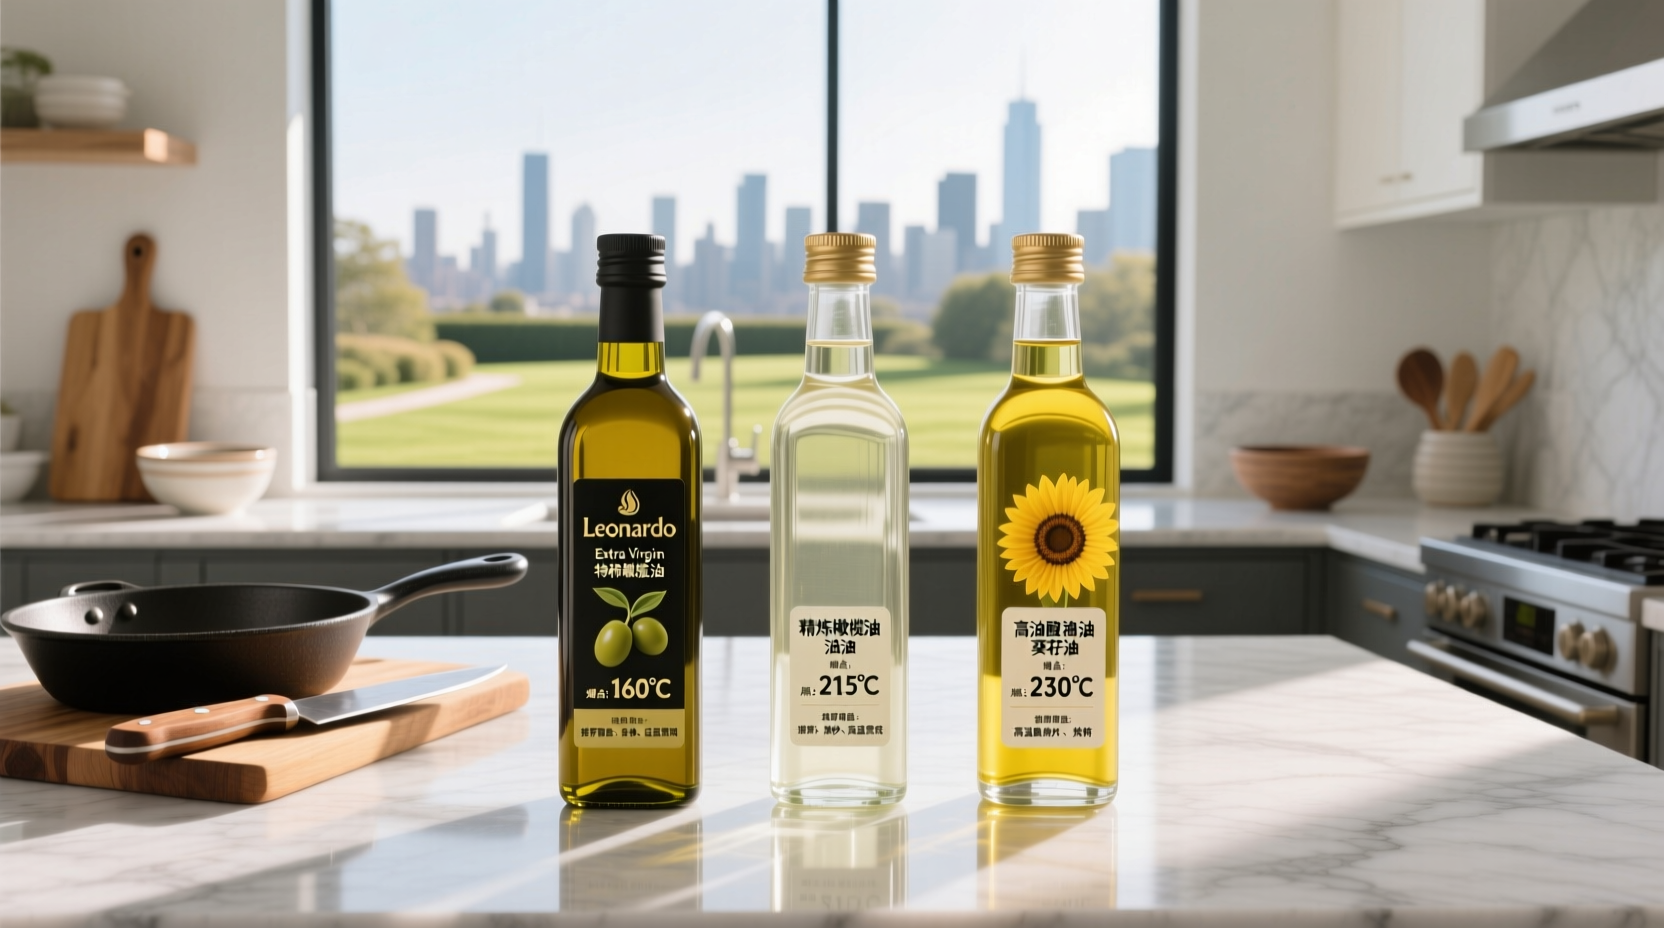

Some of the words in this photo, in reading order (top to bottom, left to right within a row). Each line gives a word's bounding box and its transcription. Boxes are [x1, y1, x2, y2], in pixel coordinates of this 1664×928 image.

[583, 516, 677, 538] Leonardo
[595, 547, 626, 560] Extra
[628, 547, 665, 563] Virgin
